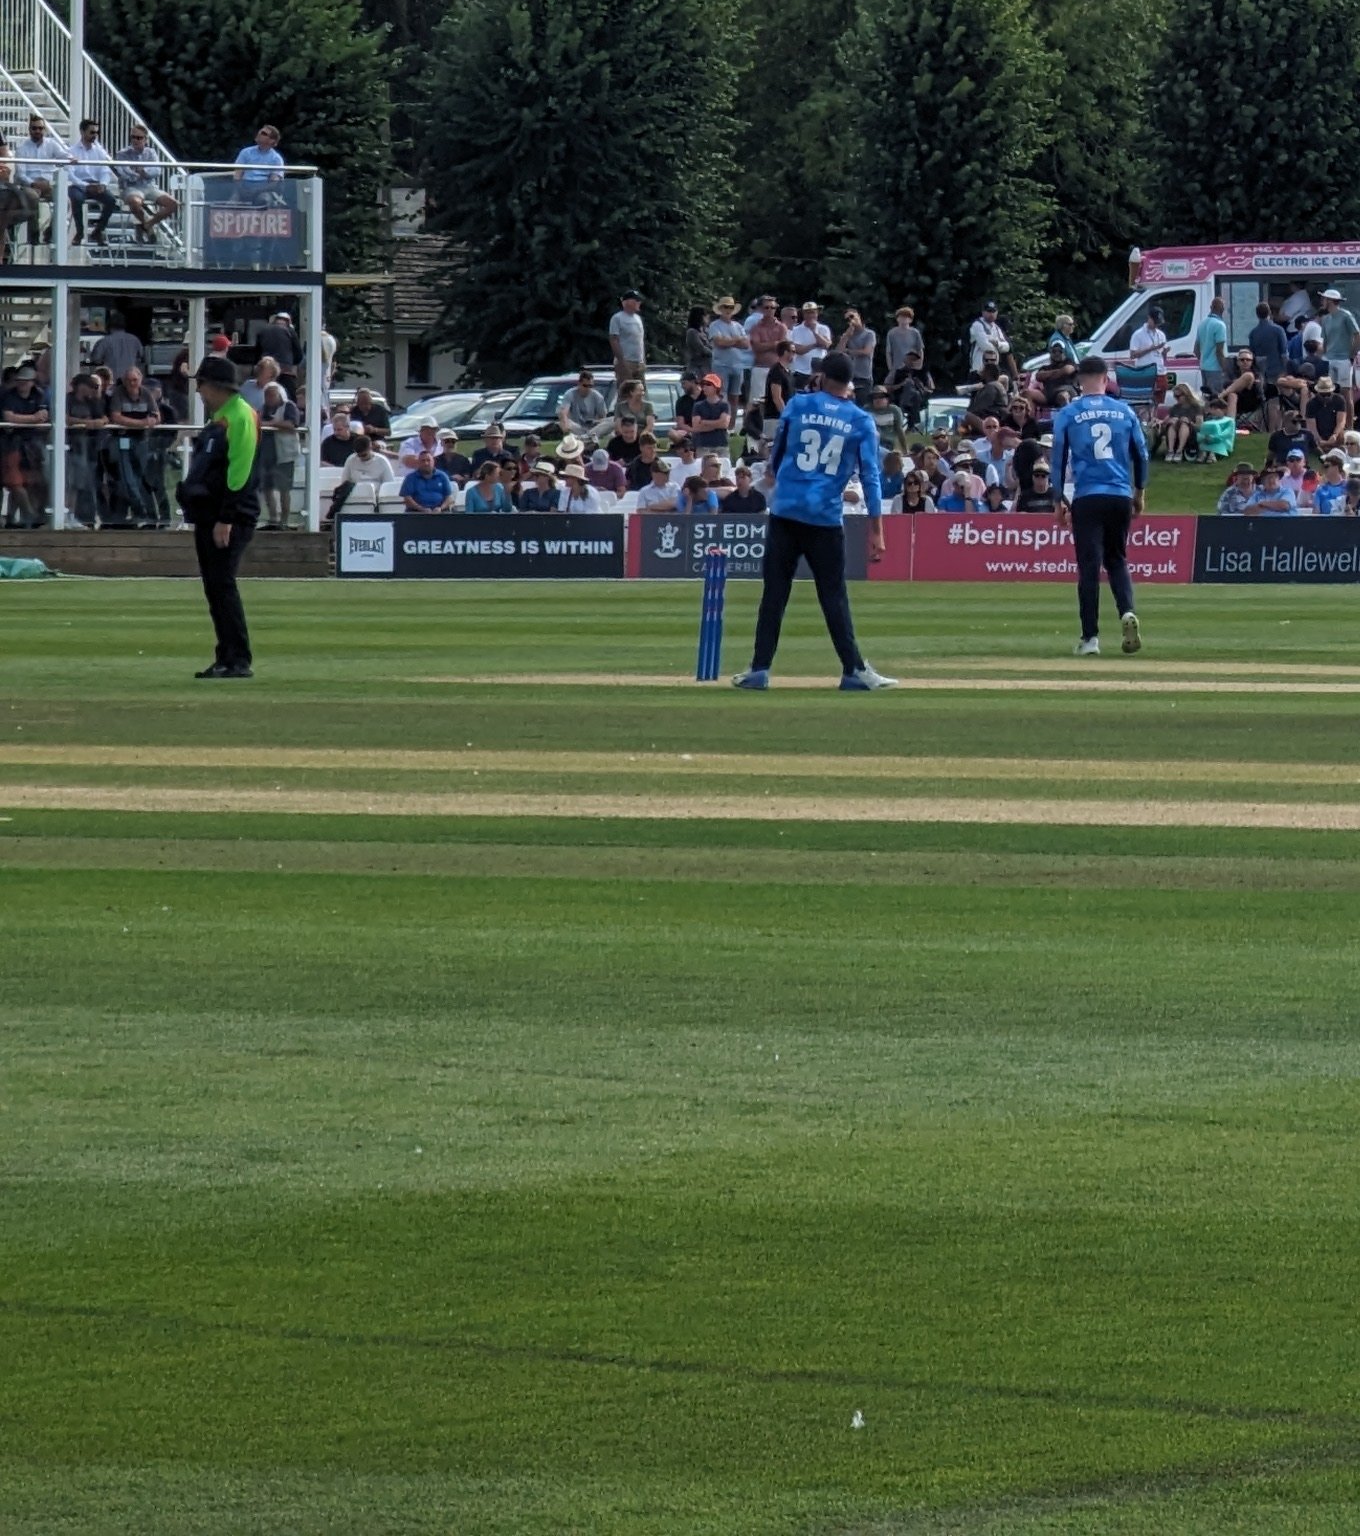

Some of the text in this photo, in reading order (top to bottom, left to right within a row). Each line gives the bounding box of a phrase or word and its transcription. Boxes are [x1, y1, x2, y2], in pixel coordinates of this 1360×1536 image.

[213, 212, 289, 235] SPITFIRE
[1254, 257, 1310, 267] ELECTRIC
[1311, 257, 1329, 267] ICE
[1091, 423, 1114, 460] 2
[797, 429, 845, 476] 34
[694, 524, 717, 539] ST
[403, 540, 614, 555] GREATNESS IS WITHIN
[692, 562, 760, 572] CAERBU
[1205, 547, 1252, 572] Lisa
